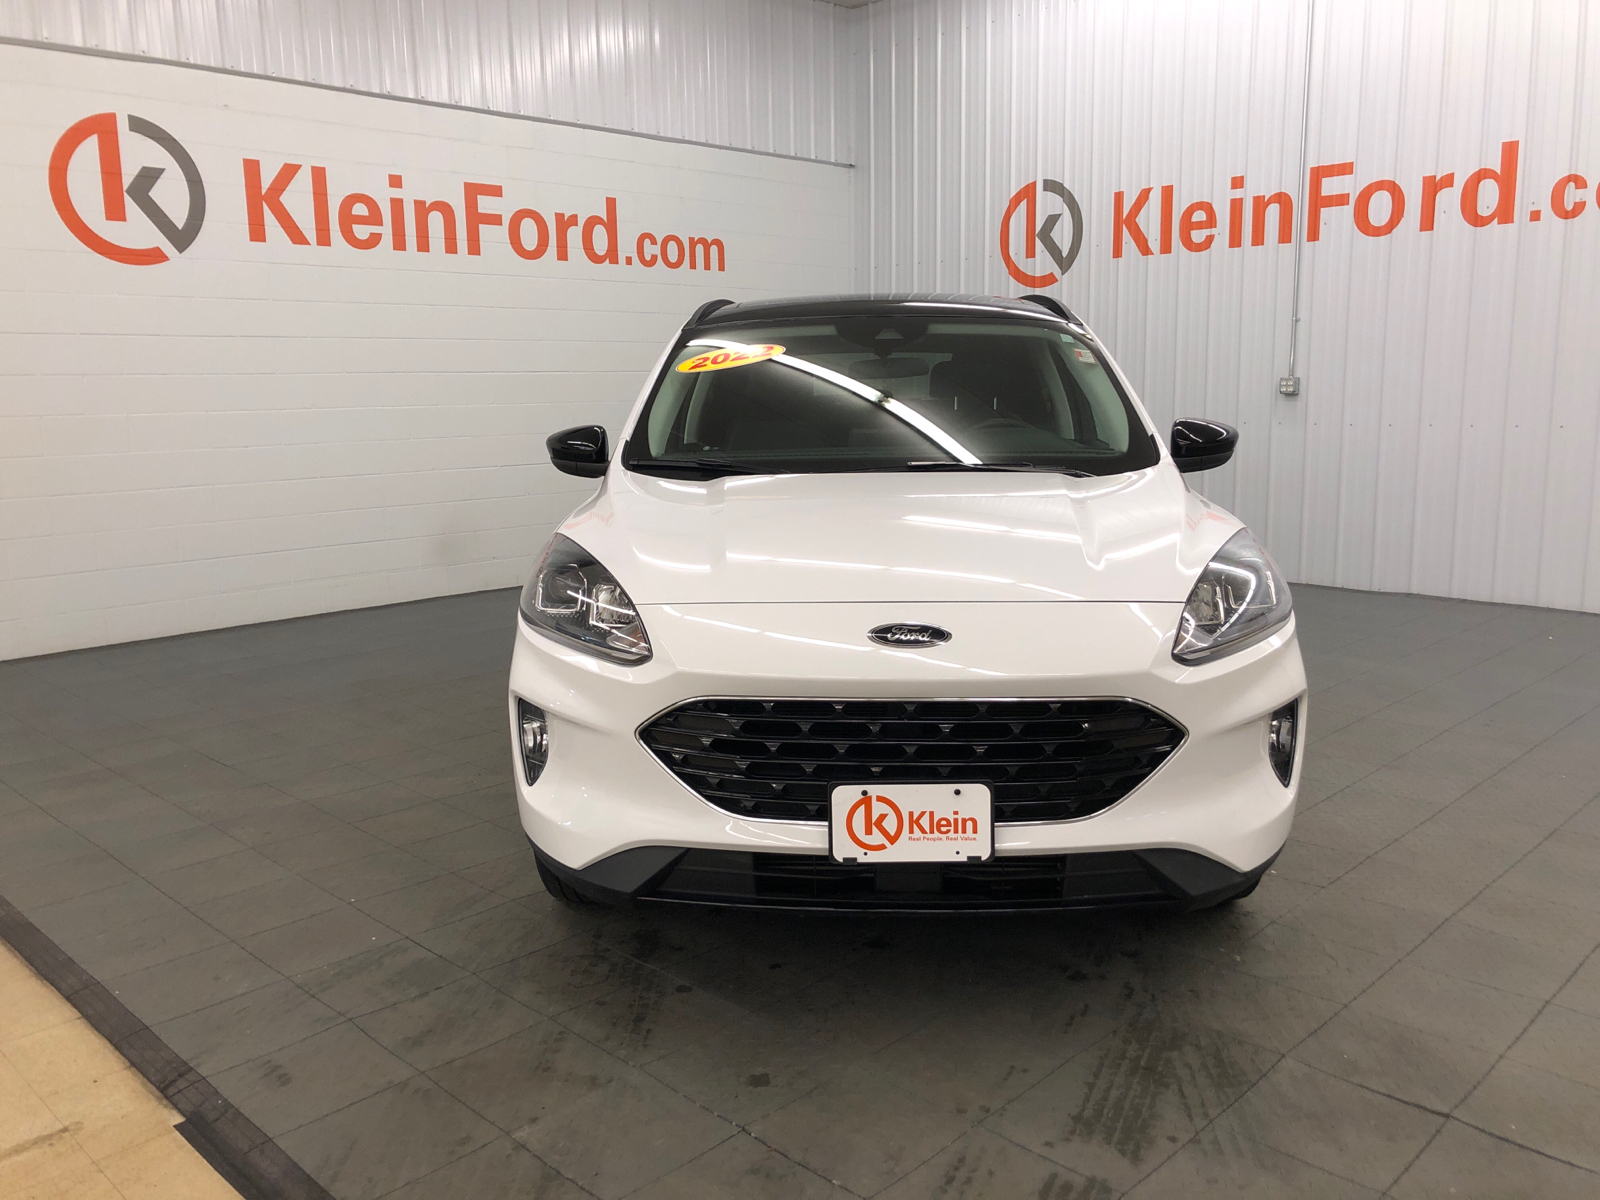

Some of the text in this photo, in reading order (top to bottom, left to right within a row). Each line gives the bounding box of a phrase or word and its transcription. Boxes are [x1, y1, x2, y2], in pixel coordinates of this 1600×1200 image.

[242, 157, 726, 271] KleinFord.com
[1112, 139, 1600, 259] KleinFord.c
[886, 625, 933, 641] Ford
[908, 810, 978, 834] Klein
